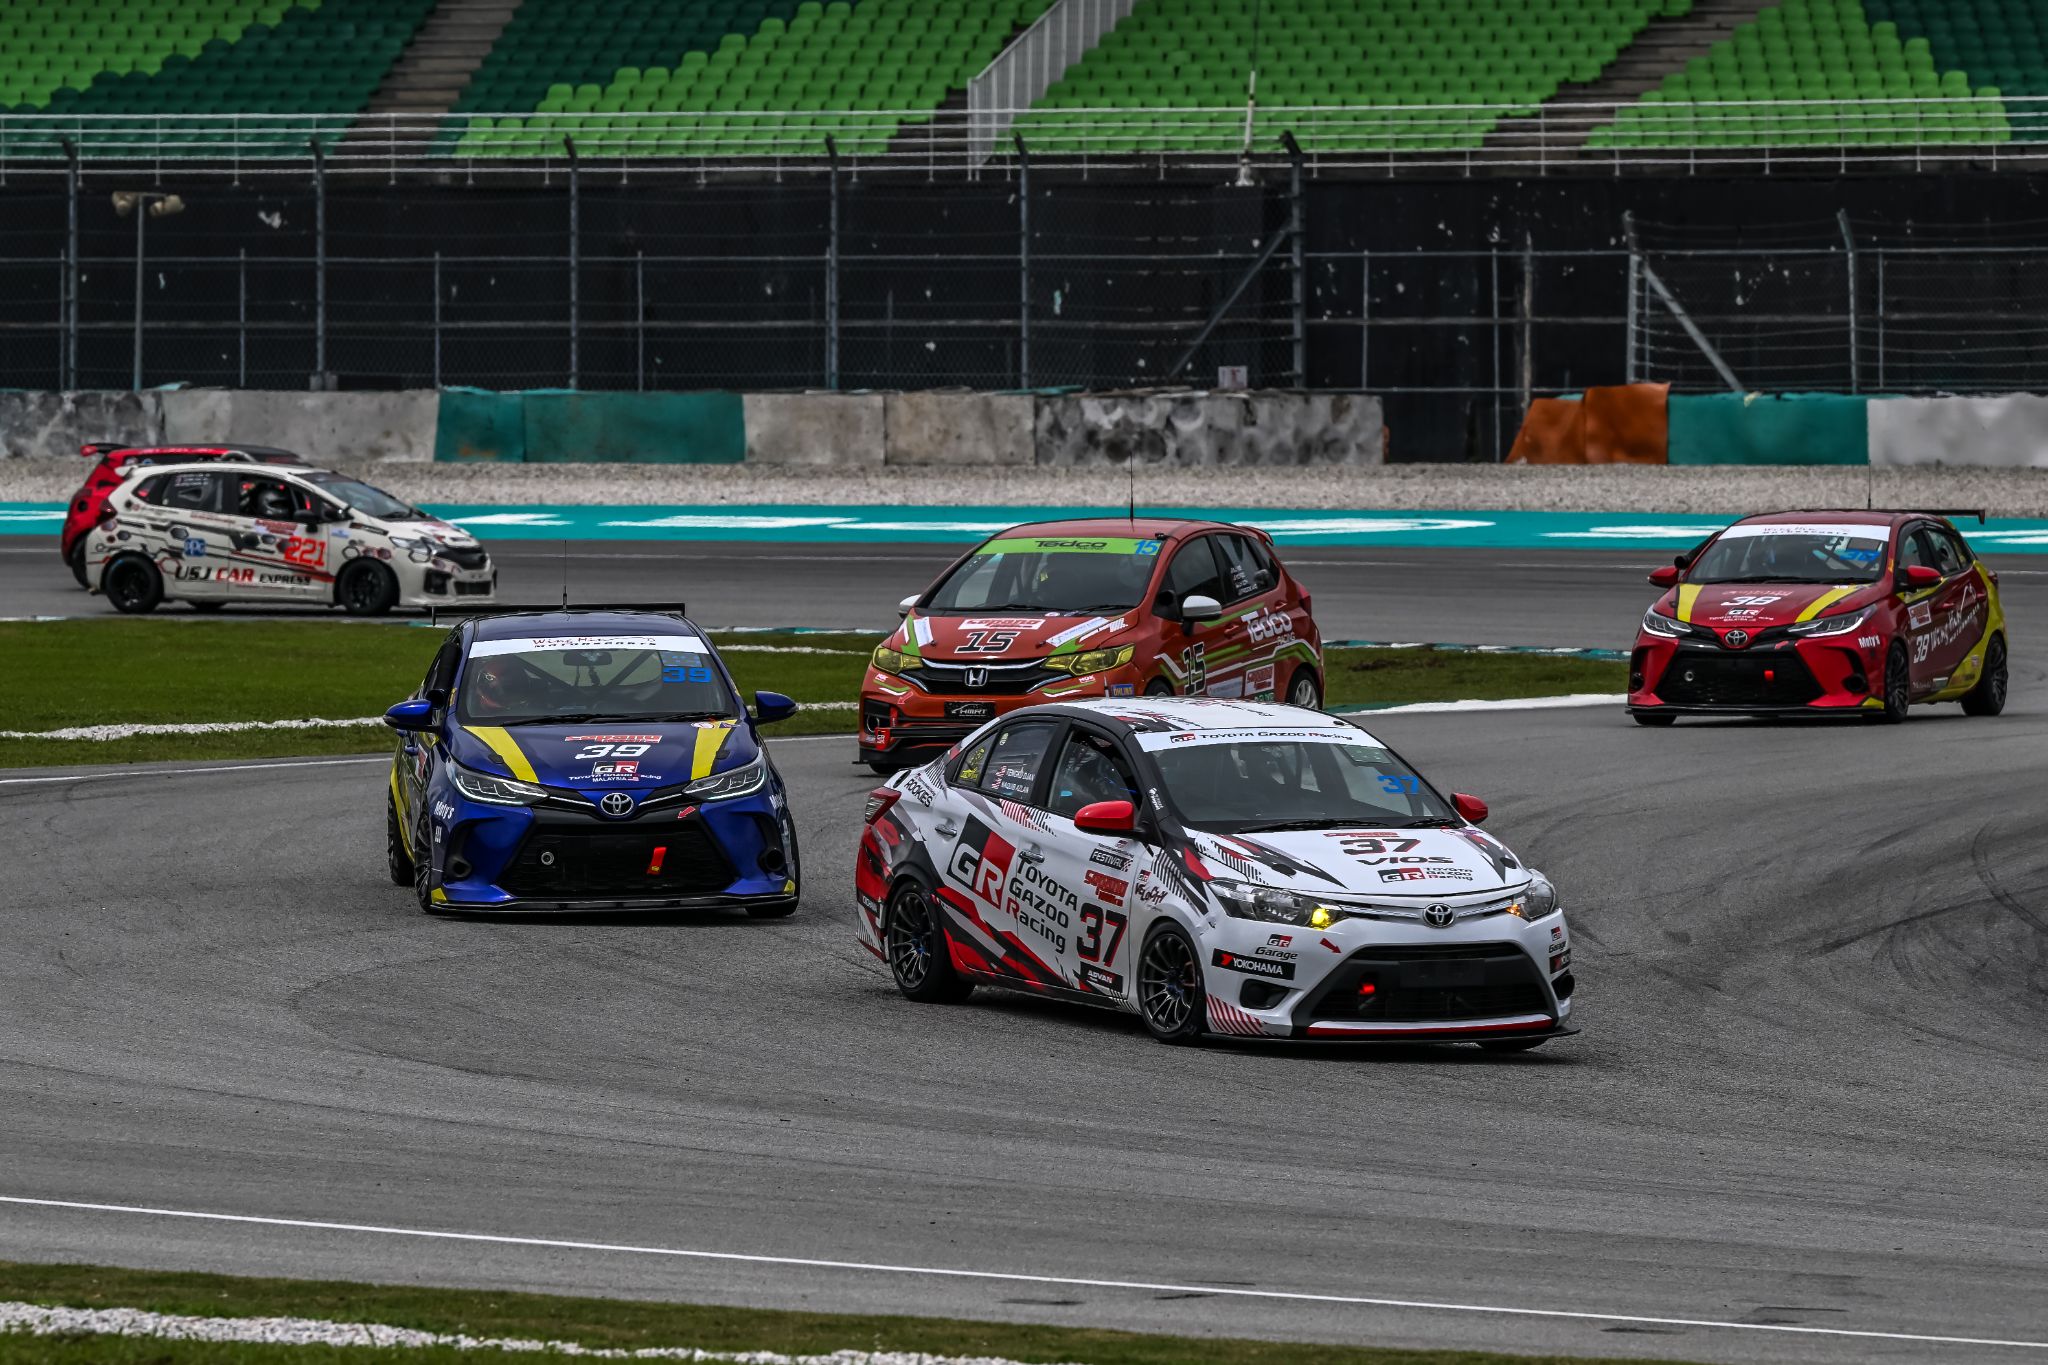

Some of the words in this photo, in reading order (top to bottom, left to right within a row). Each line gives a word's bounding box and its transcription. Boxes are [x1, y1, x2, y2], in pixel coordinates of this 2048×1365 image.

[284, 536, 326, 567] 221
[1035, 540, 1107, 549] Tedco
[1135, 540, 1161, 555] 15
[175, 565, 212, 580] USJ
[215, 567, 255, 582] CAR
[259, 573, 312, 586] EXPRESS
[1241, 607, 1293, 644] Tedco
[954, 631, 1021, 654] 15
[1913, 634, 1930, 664] 38
[662, 667, 712, 683] 39
[1183, 641, 1206, 697] 15
[574, 744, 652, 760] 39
[594, 764, 636, 773] GR
[904, 778, 933, 808] ROOKIES
[1377, 775, 1419, 794] 37
[1339, 838, 1421, 855] 37
[1092, 851, 1123, 869] FESTIVAL
[1356, 856, 1454, 866] VIOS
[950, 842, 1004, 907] GR
[1381, 870, 1425, 882] GR
[1017, 858, 1078, 912] TOYOTA
[1008, 877, 1070, 929] GAZOO
[1006, 896, 1066, 955] Racing
[1077, 902, 1128, 968] 37
[1268, 938, 1291, 947] GR
[1255, 946, 1298, 960] Garage
[1232, 957, 1284, 975] YOKOHAMA
[1087, 969, 1113, 984] ADVAN
